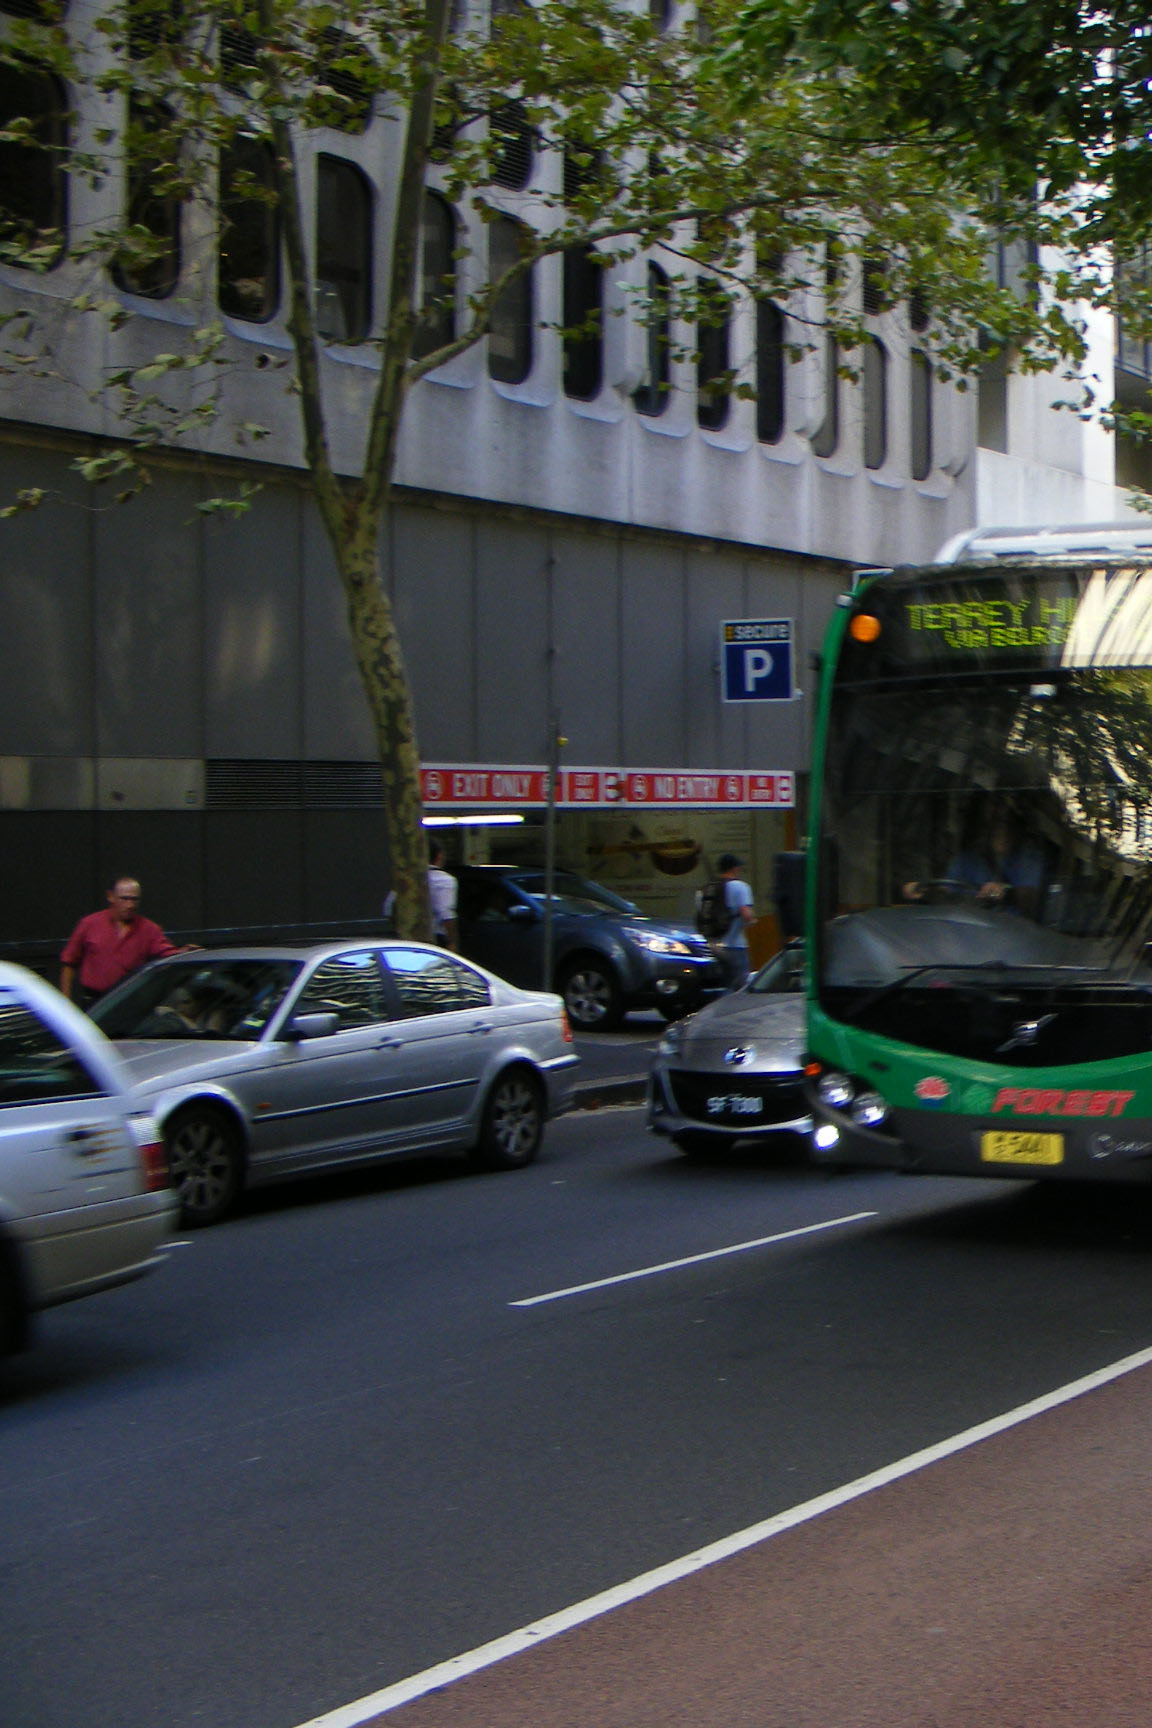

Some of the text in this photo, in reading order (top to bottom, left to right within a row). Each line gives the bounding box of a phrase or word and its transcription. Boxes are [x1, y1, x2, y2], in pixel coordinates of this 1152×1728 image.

[905, 600, 1031, 631] TERREY
[744, 650, 773, 692] P
[452, 773, 532, 798] EXIT ONLY
[654, 776, 721, 799] NO ENTRY
[991, 1087, 1135, 1118] FOREST
